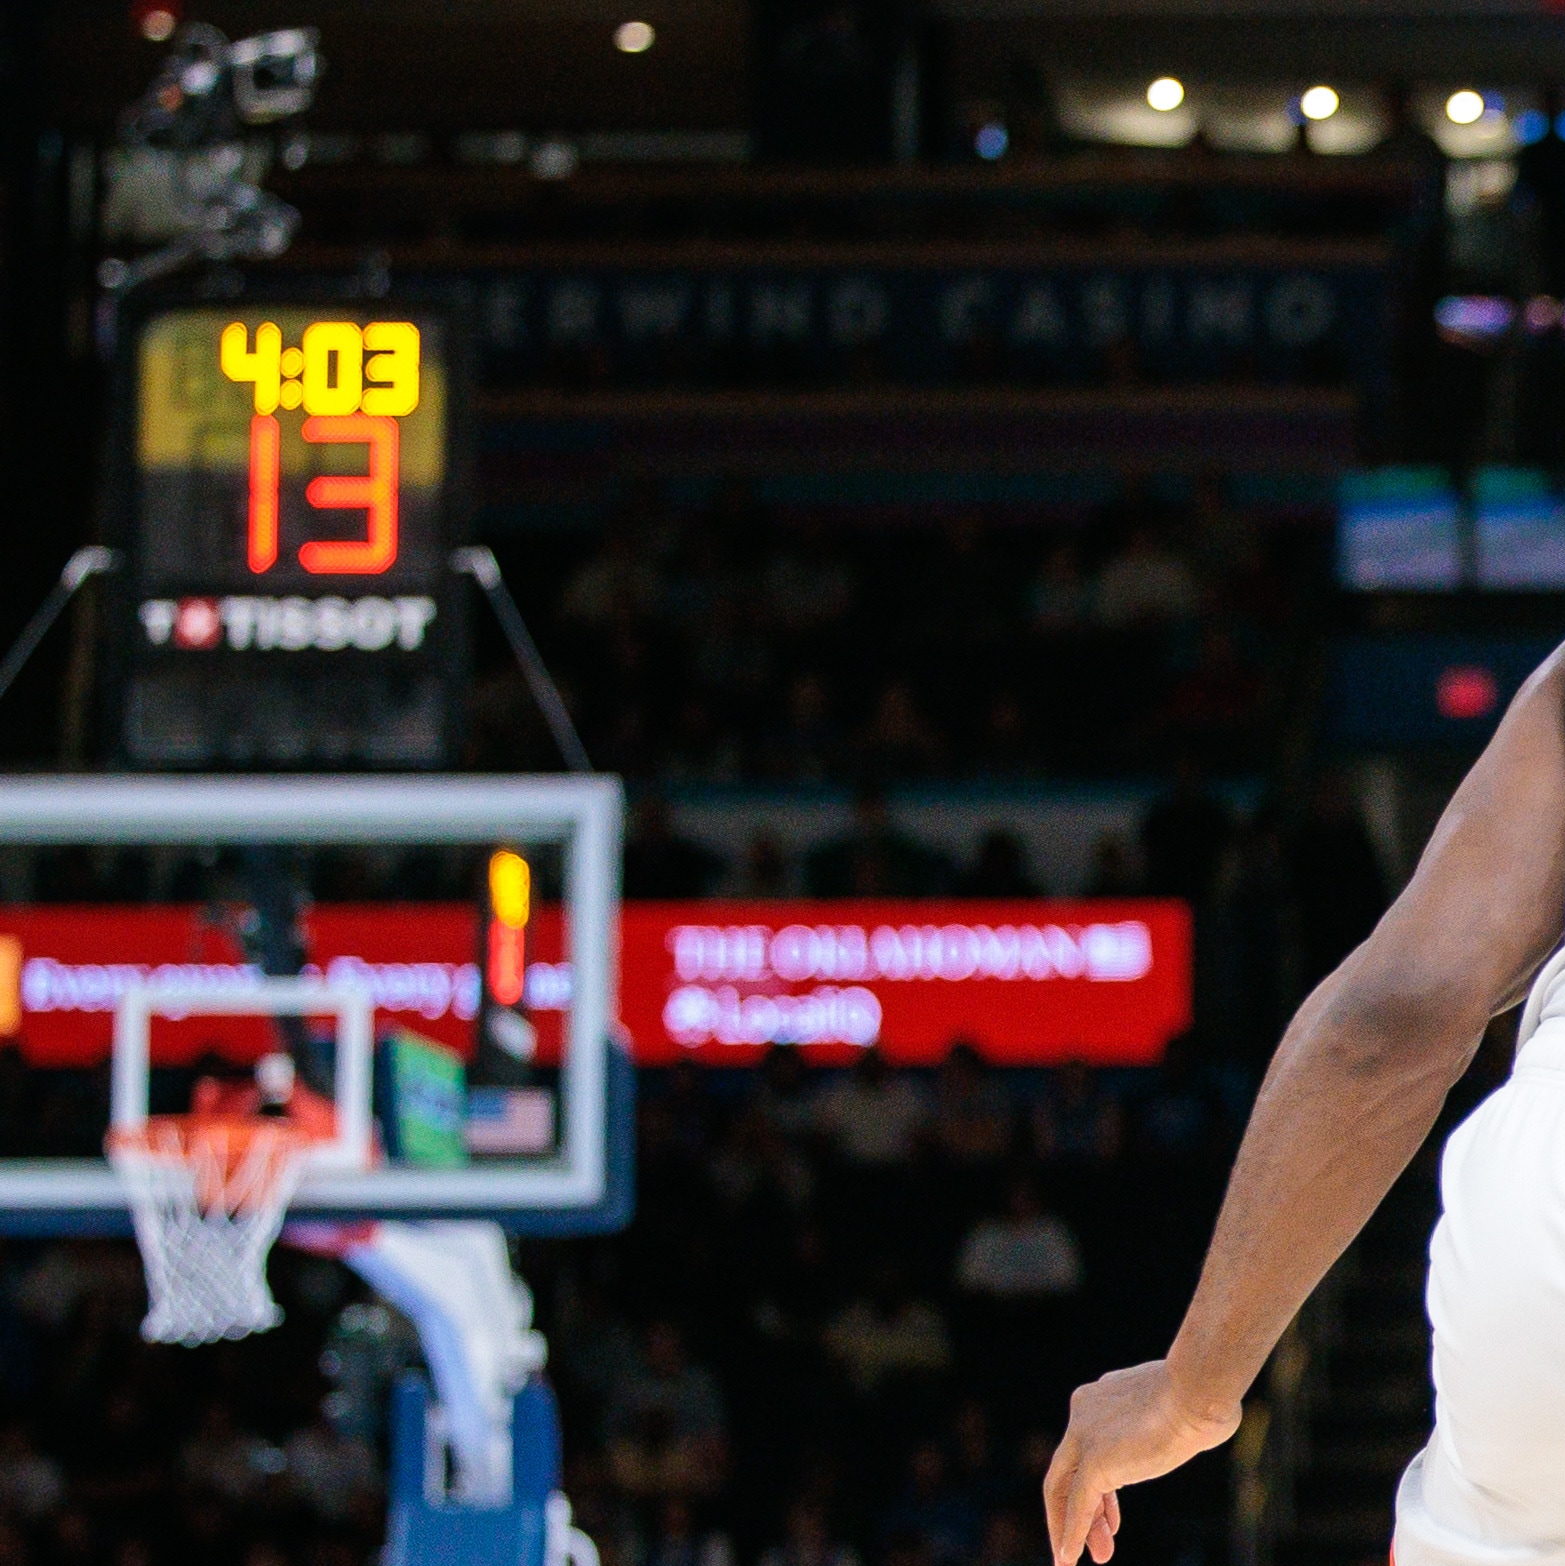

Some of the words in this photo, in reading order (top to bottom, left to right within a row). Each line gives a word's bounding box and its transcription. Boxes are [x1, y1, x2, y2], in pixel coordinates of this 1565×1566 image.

[220, 321, 421, 417] 4:03
[247, 413, 400, 576] 13
[220, 595, 438, 651] TISSOT
